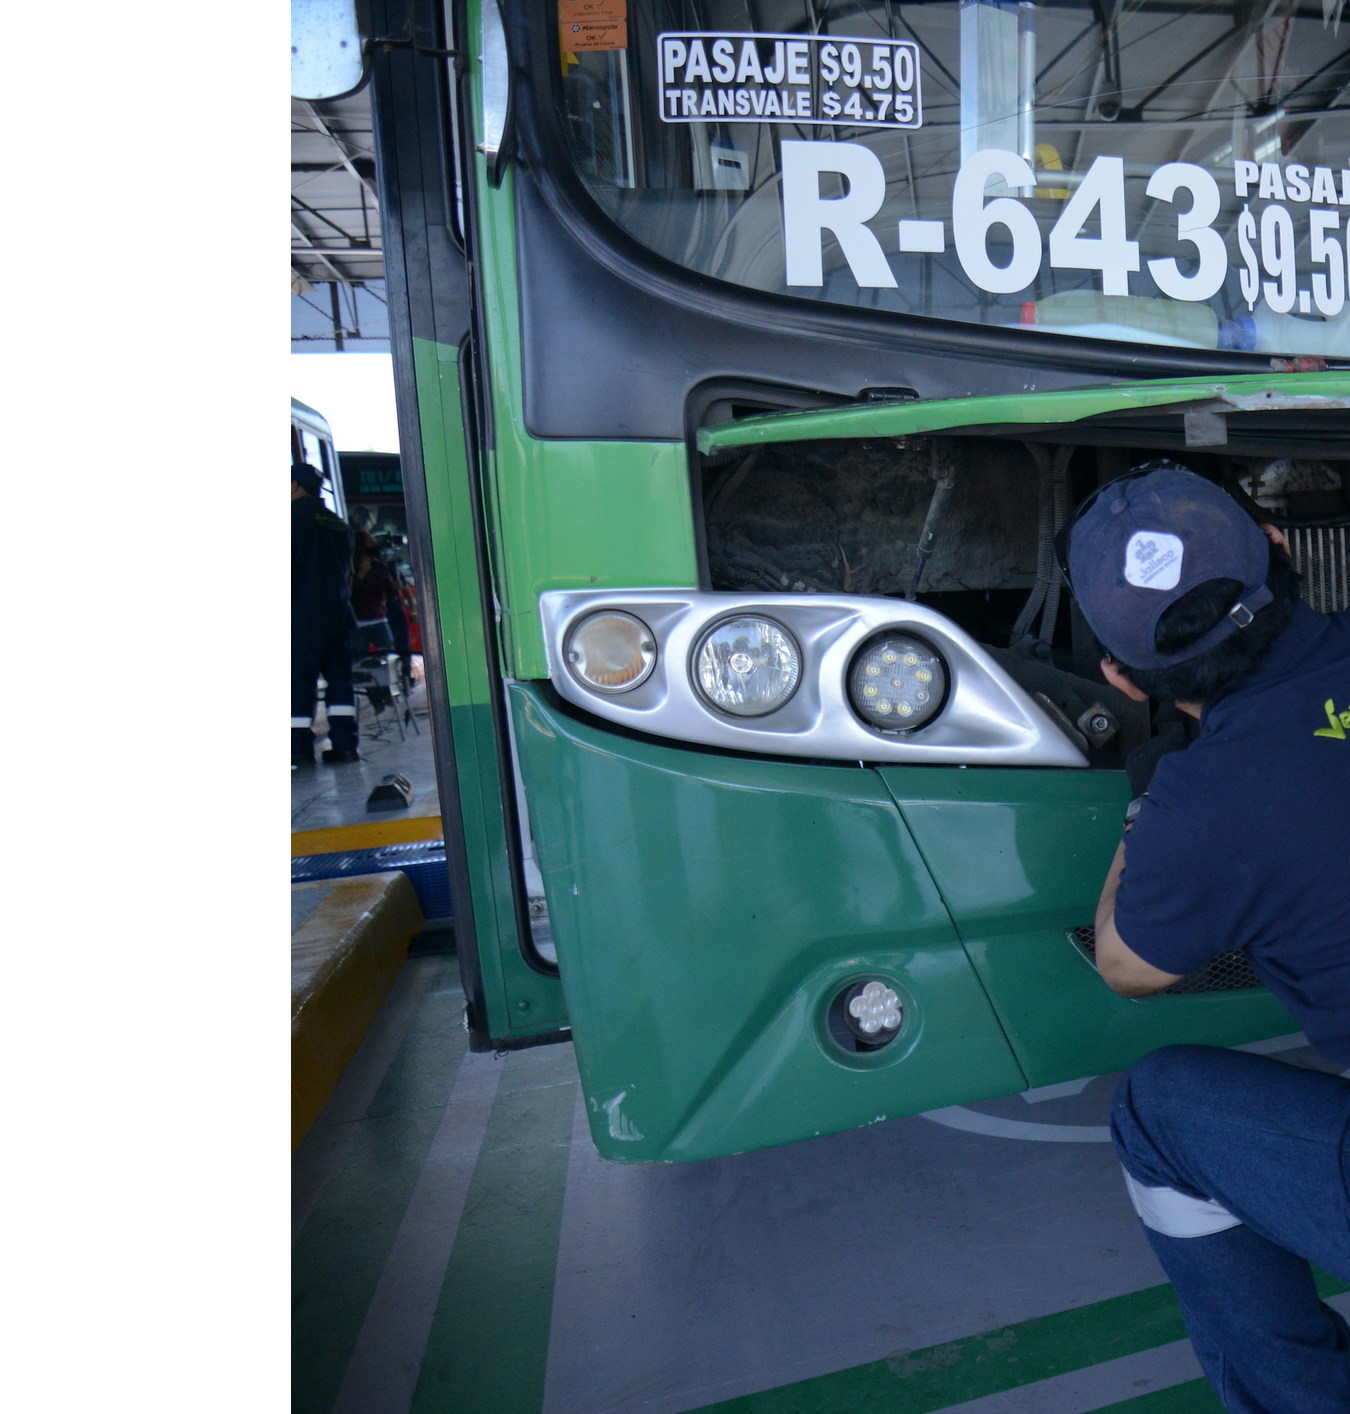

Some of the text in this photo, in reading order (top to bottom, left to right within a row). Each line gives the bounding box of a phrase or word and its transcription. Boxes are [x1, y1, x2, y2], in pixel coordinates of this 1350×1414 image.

[582, 24, 618, 32] Marcopolo
[664, 39, 915, 92] PASAJE $9.50
[665, 89, 915, 122] TRANSVALE $4.75
[780, 139, 1229, 302] R-643
[1140, 550, 1175, 579] Jalisco
